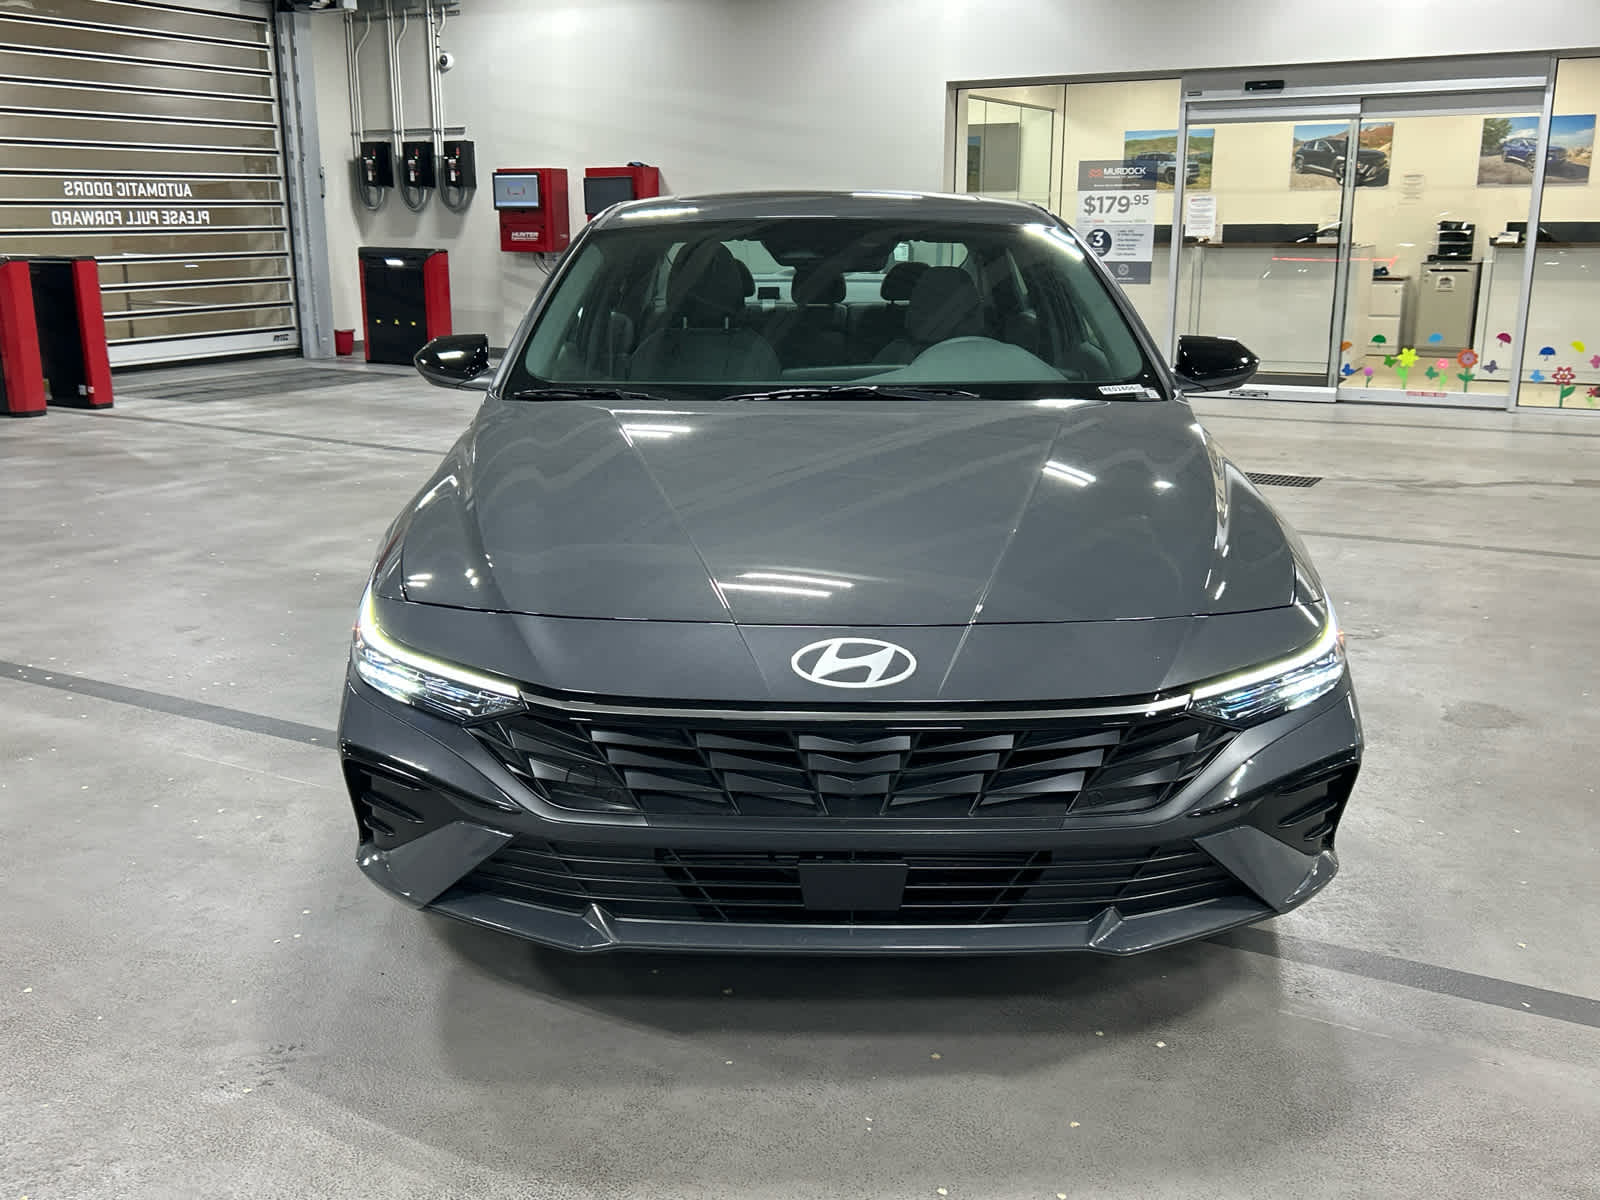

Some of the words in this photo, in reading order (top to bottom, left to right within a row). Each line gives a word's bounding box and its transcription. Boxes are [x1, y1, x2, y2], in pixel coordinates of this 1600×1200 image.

[1103, 167, 1147, 175] MURDOCK
[1083, 194, 1150, 216] $179.95
[1092, 231, 1105, 247] 3
